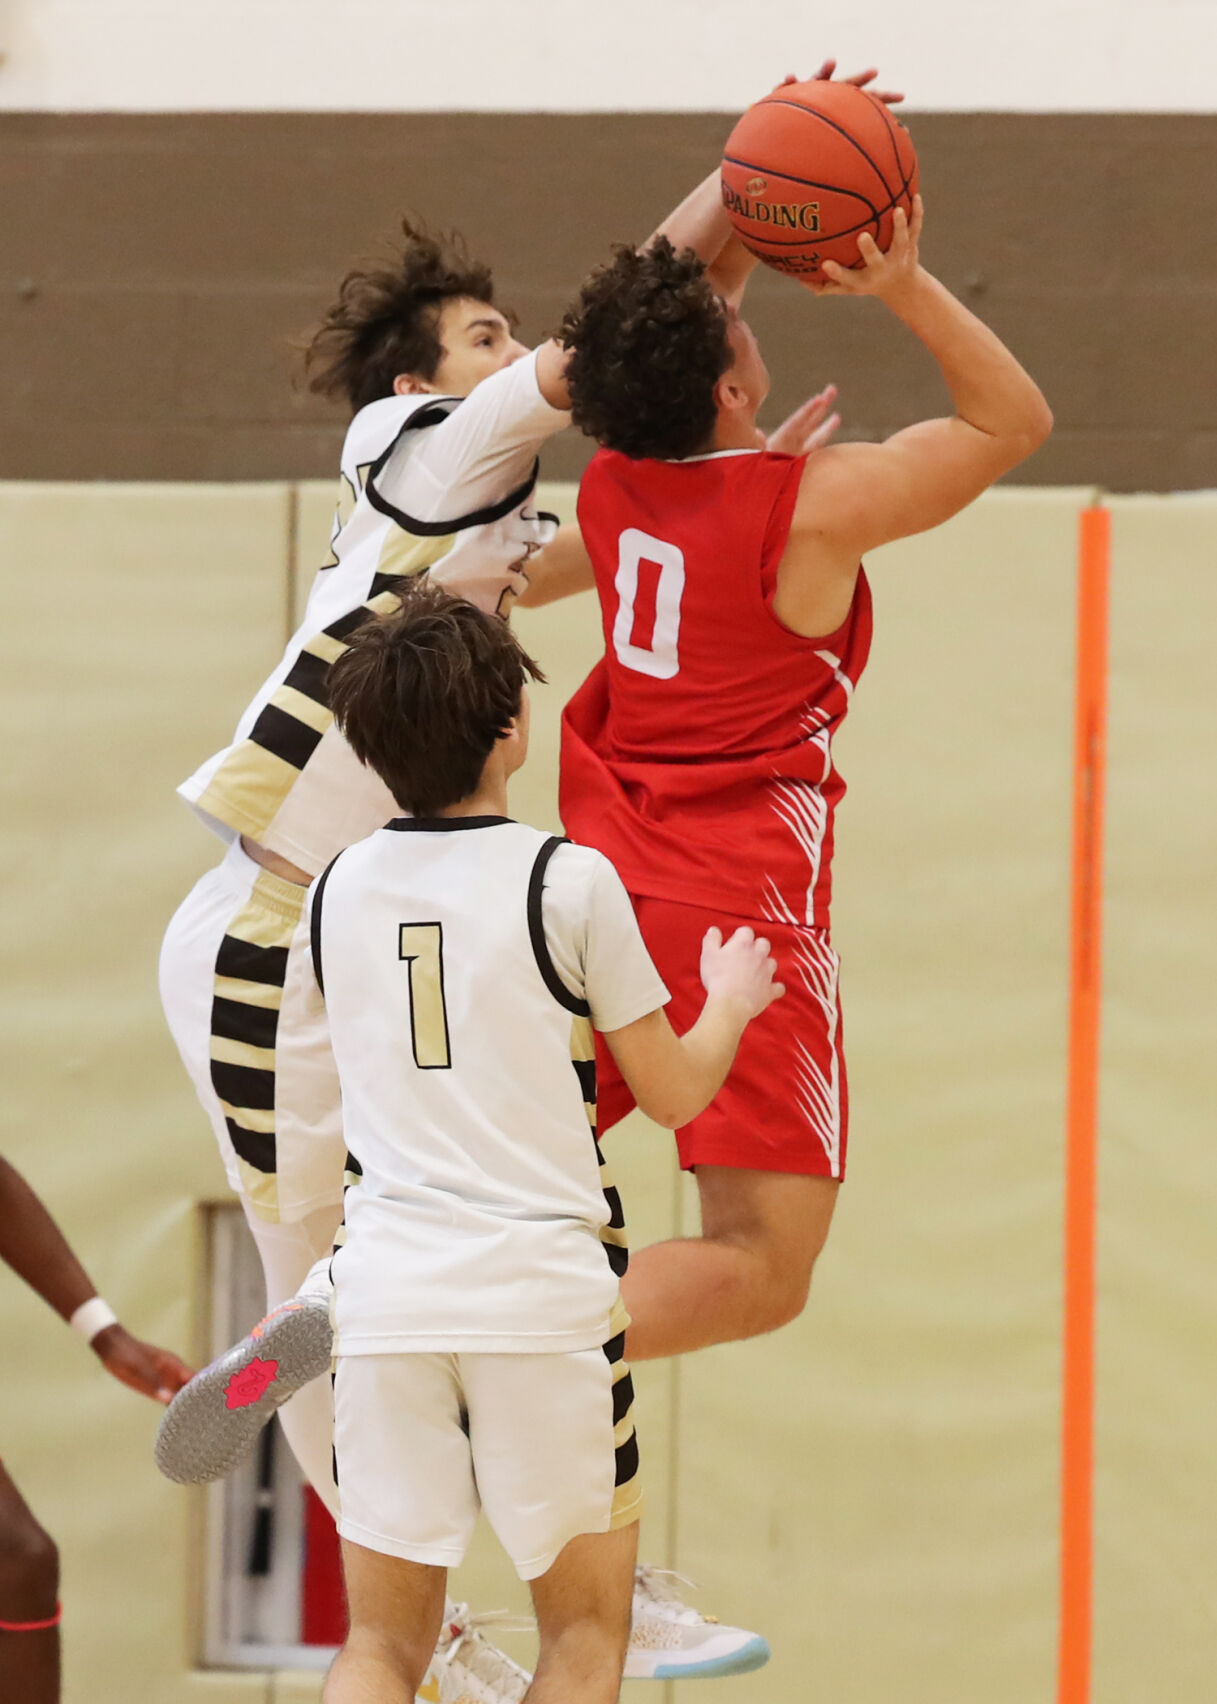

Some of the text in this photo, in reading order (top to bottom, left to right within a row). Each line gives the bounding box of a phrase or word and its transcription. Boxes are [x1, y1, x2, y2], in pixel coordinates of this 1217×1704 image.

[721, 180, 819, 232] PALDING
[612, 528, 686, 680] 0
[399, 922, 452, 1069] 1
